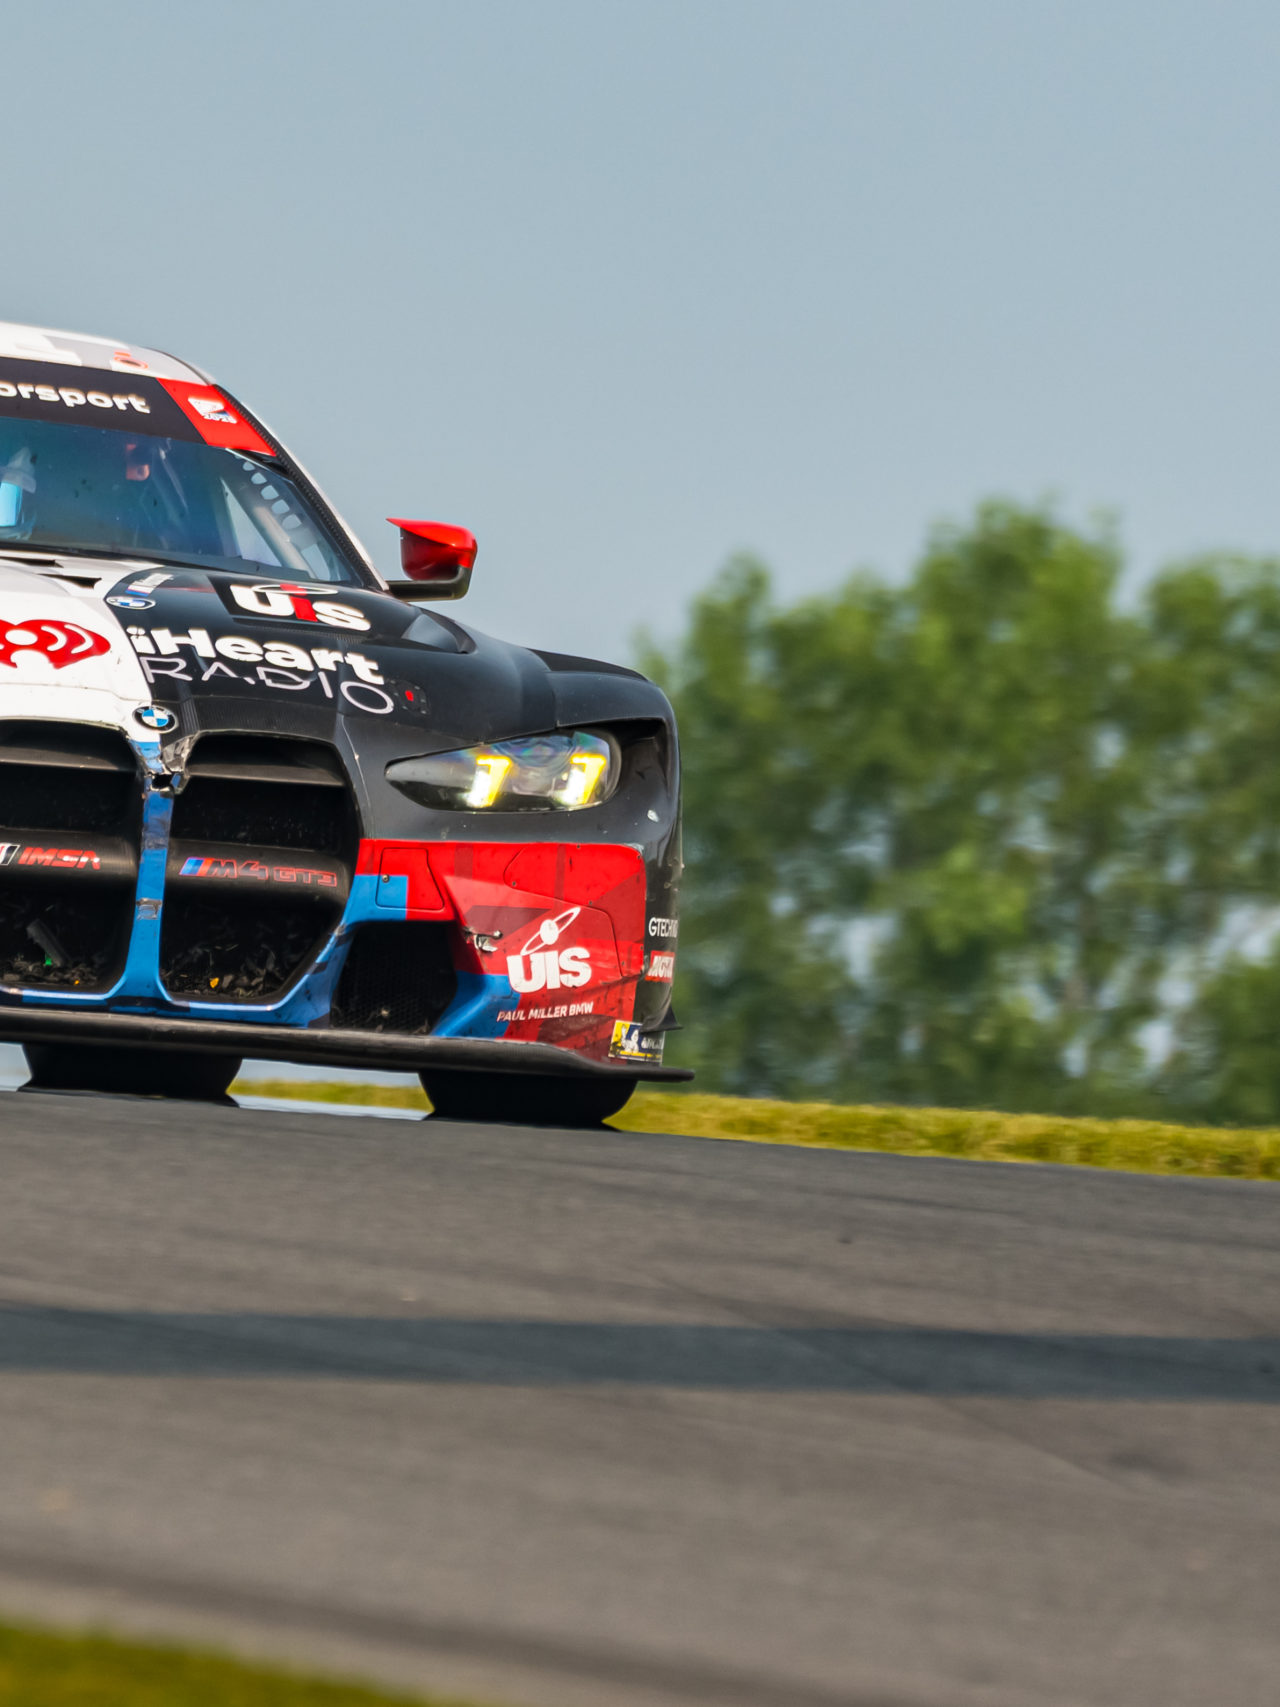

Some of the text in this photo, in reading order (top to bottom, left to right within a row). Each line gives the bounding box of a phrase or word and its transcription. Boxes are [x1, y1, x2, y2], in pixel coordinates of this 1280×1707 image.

[126, 625, 384, 685] iHeart
[139, 655, 394, 714] RADIO
[18, 847, 100, 870] IMSA
[207, 858, 337, 887] M4 GT3
[497, 1001, 594, 1022] PAUL MILLER BMW
